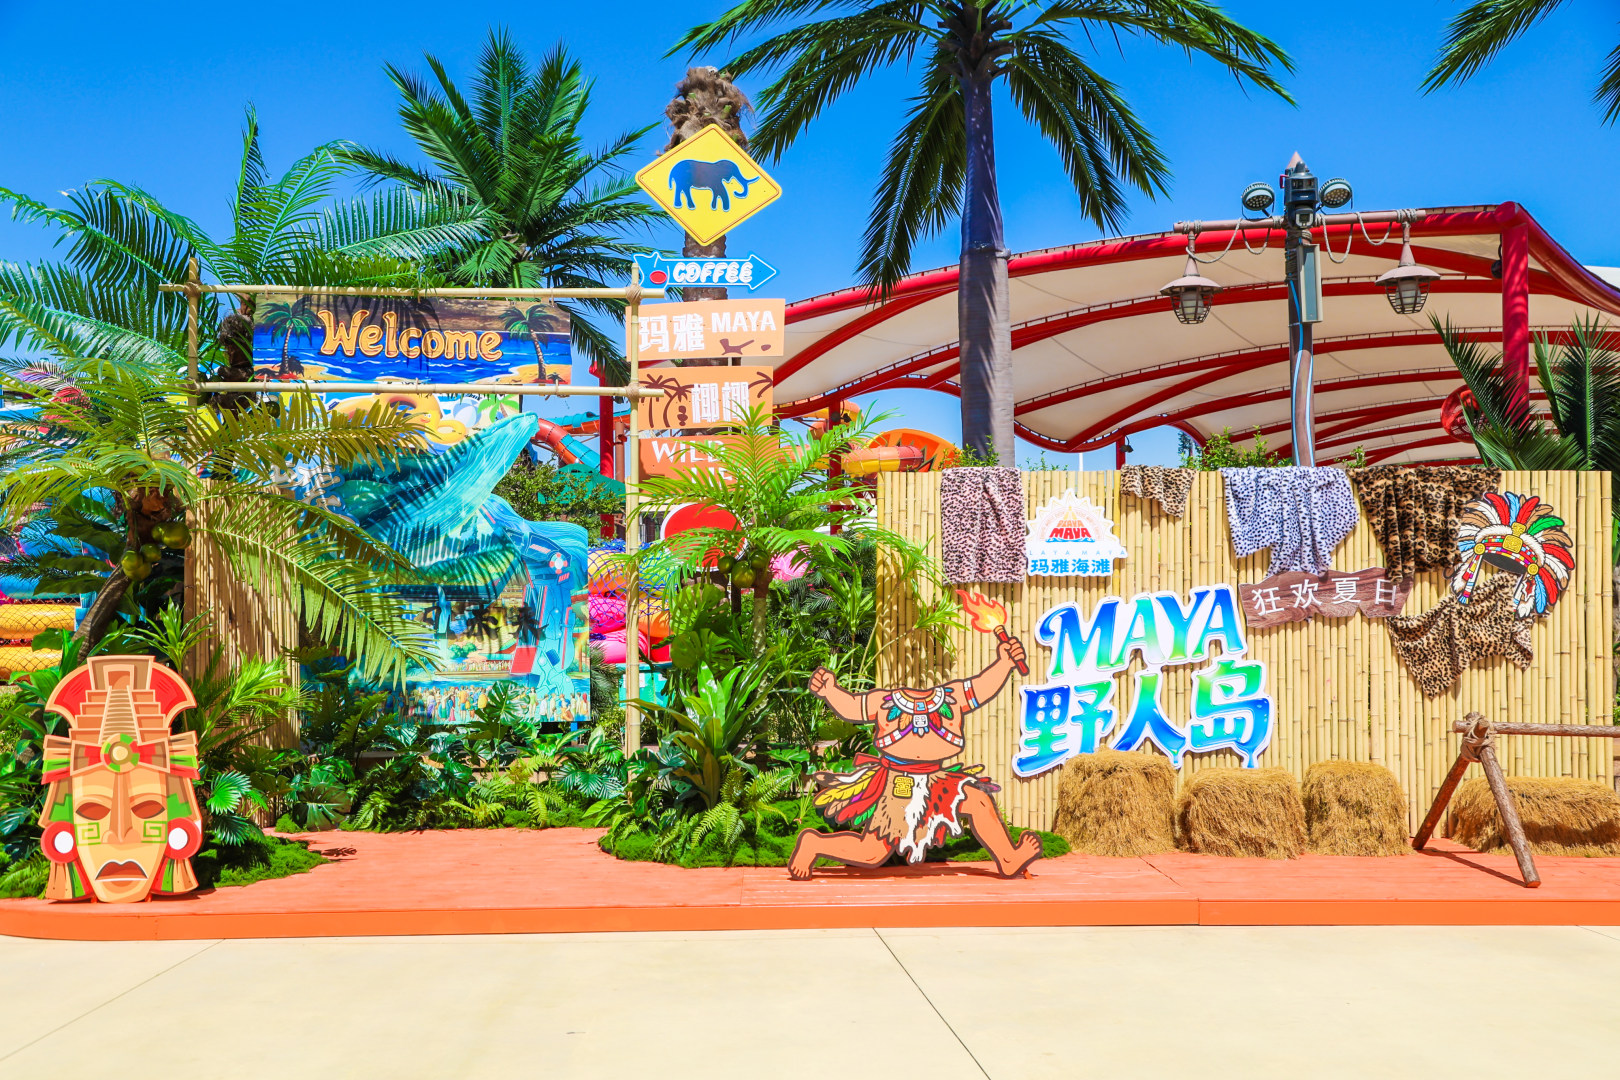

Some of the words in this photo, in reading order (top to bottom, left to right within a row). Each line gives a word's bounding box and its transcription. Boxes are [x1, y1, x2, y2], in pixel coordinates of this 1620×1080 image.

[672, 262, 753, 283] COFFEE
[317, 309, 503, 361] Welcome
[638, 312, 705, 353] 玛雅
[711, 310, 777, 333] MAYA
[651, 440, 727, 463] WILD
[1049, 527, 1092, 539] MAYA
[1030, 558, 1111, 574] 玛雅海滩
[1251, 576, 1397, 617] 狂欢夏日
[1039, 588, 1244, 677] MAYA
[1016, 660, 1270, 772] 野人岛
